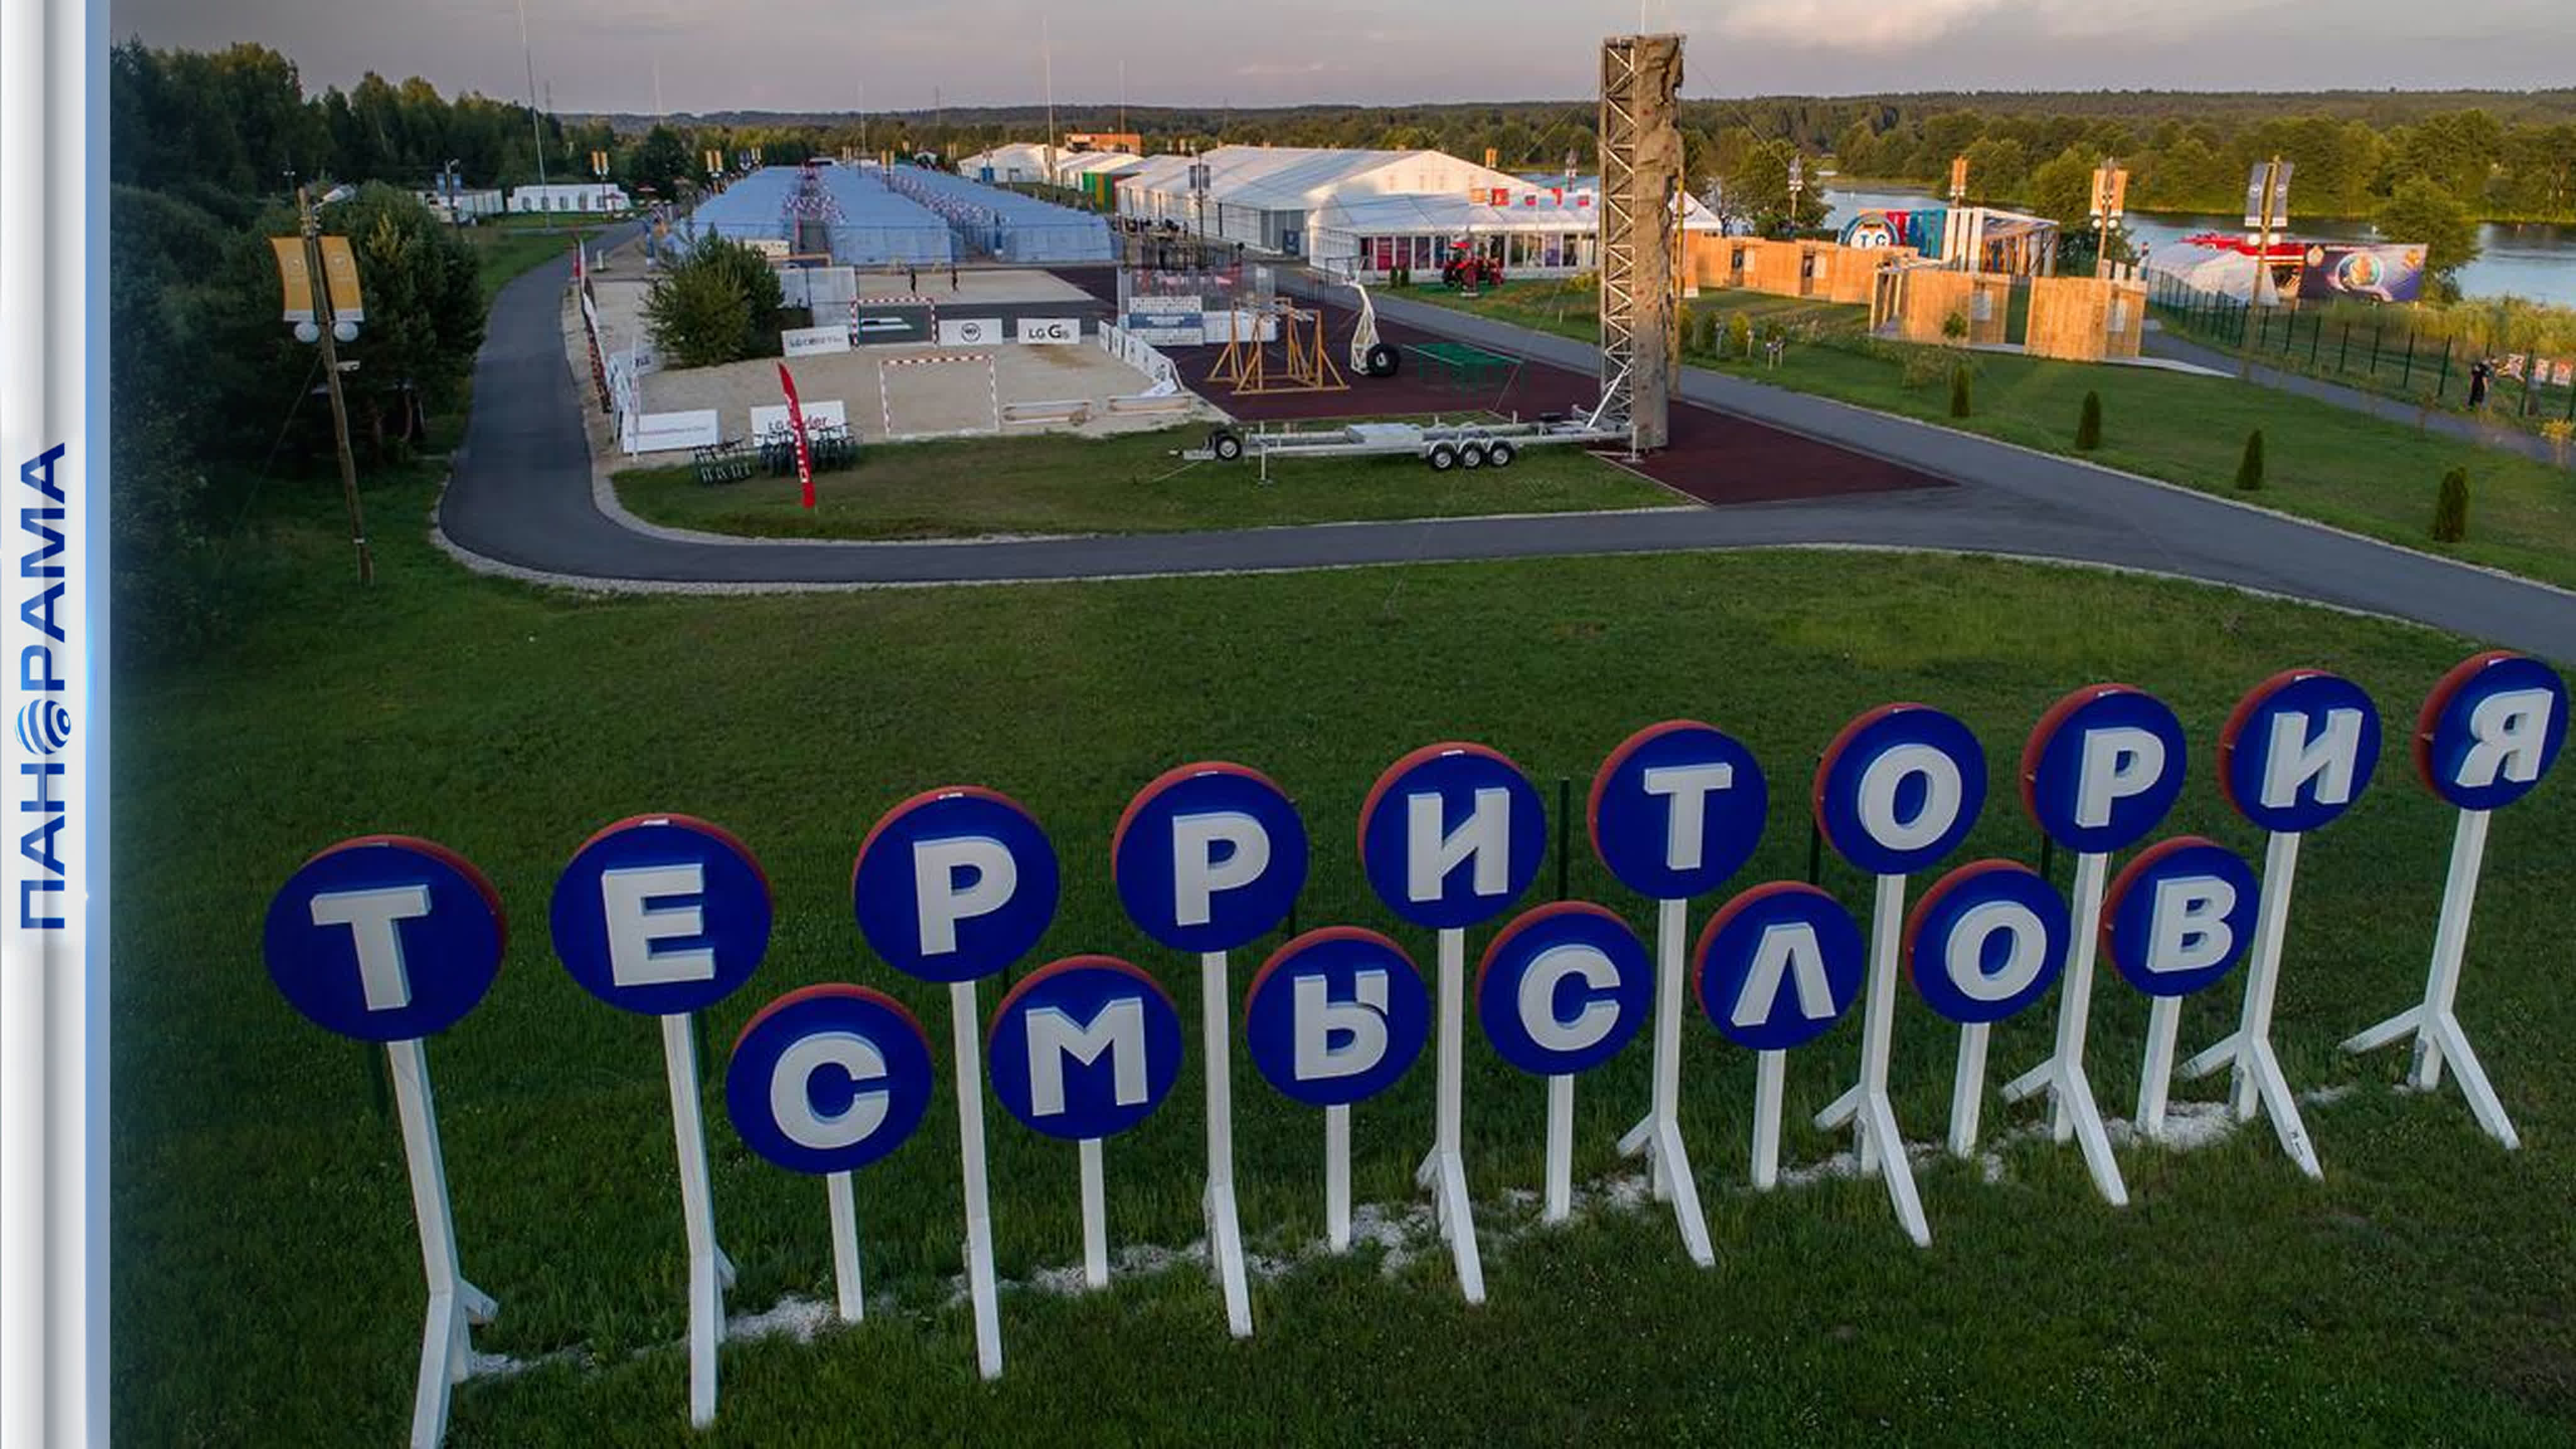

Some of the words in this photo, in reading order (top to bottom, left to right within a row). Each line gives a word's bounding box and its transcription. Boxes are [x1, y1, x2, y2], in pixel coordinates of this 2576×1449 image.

[1029, 328, 1045, 339] LG
[310, 689, 2554, 1011] ТЕРРИТОРИЯ
[770, 876, 2236, 1149] СМЫСЛОВ
